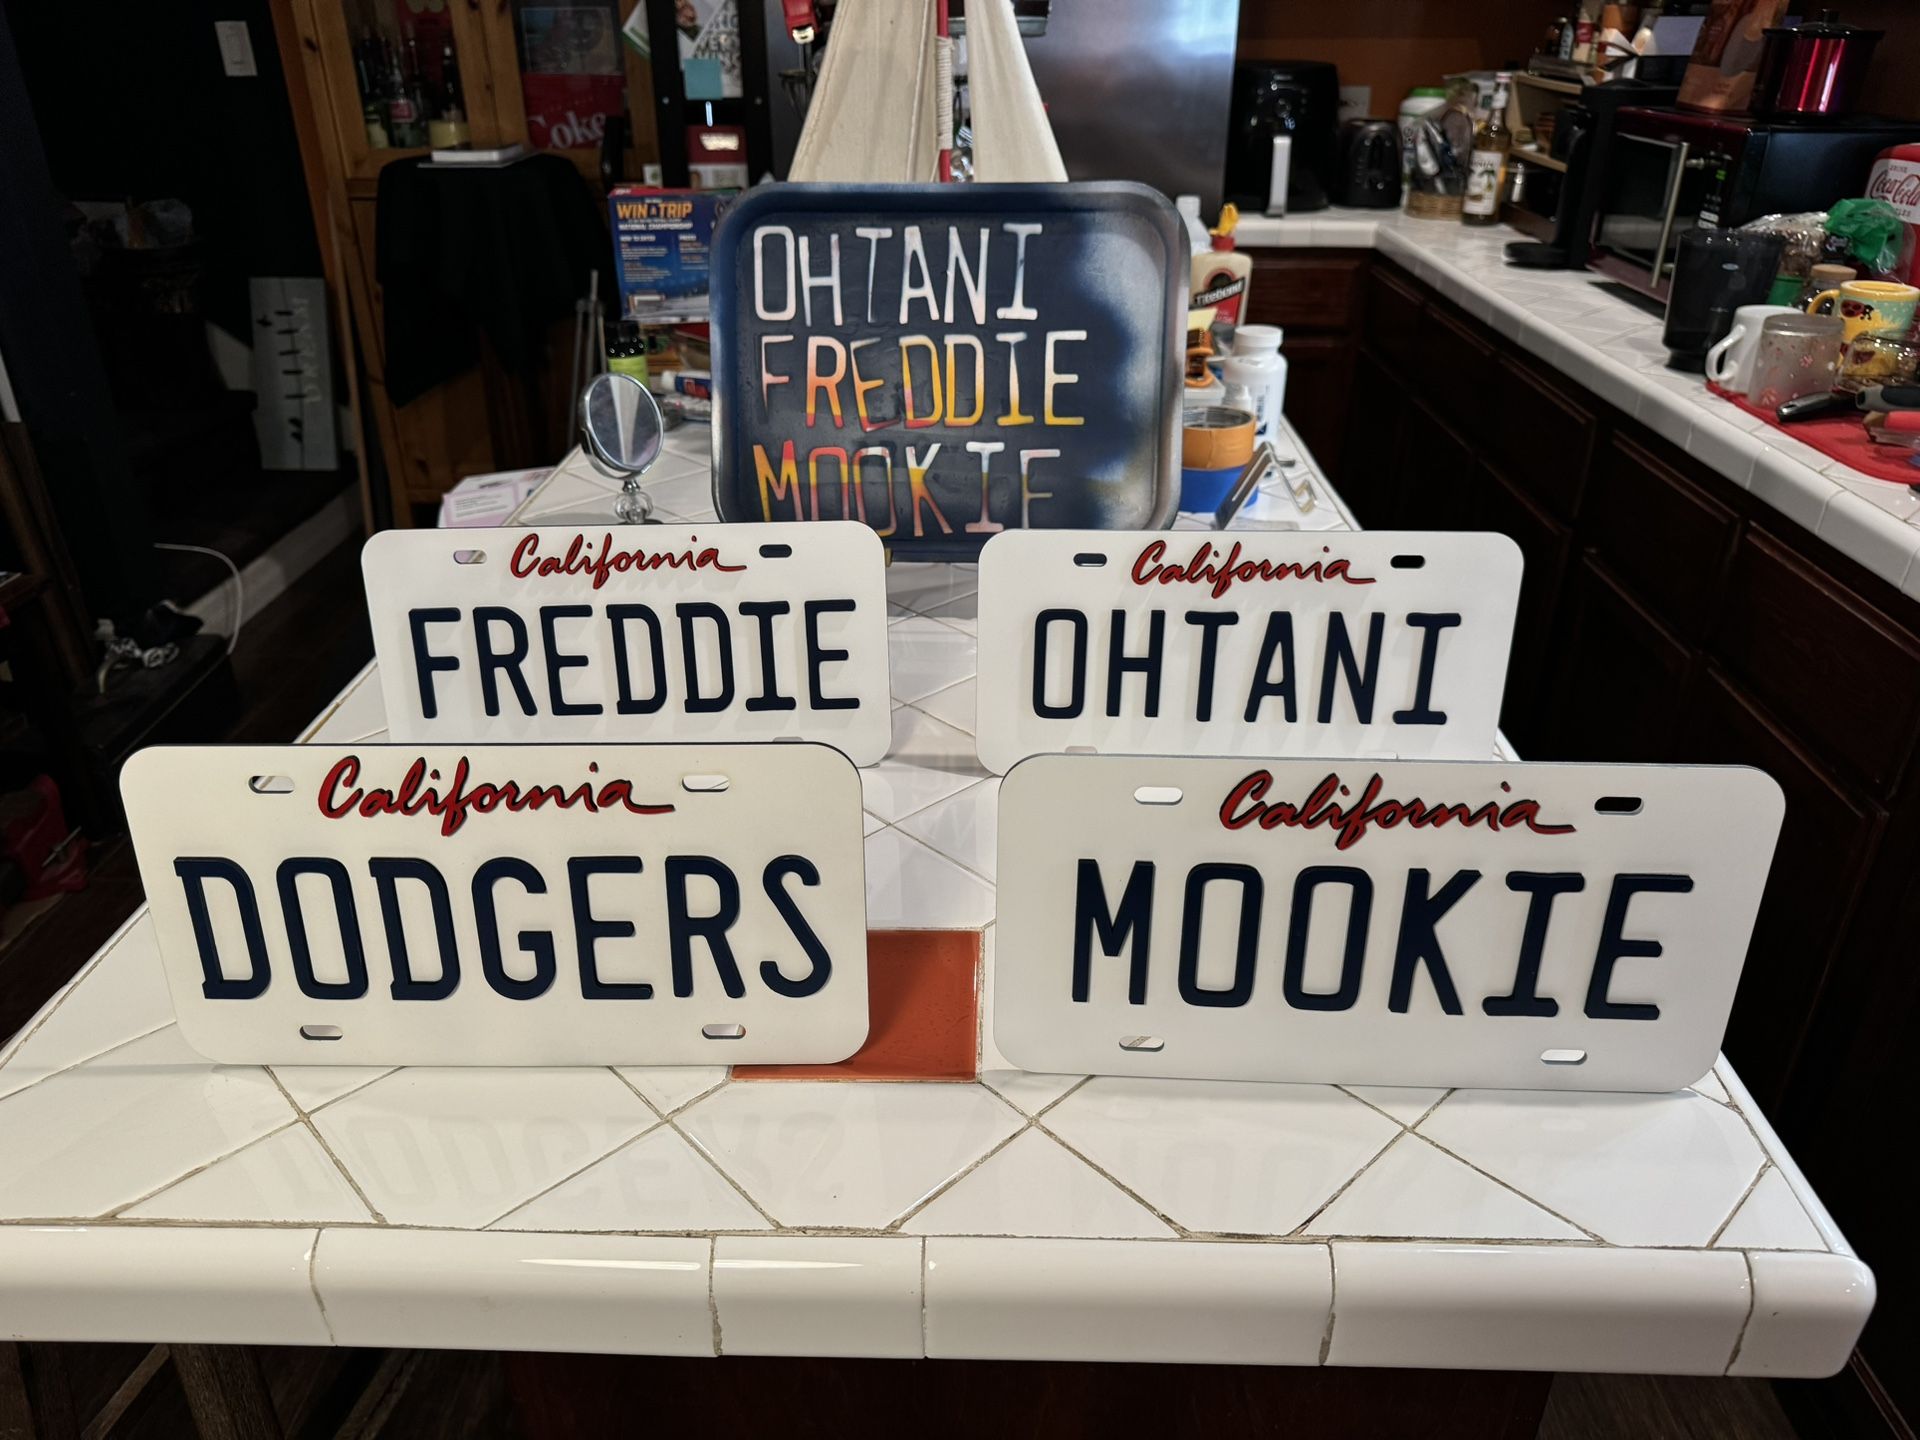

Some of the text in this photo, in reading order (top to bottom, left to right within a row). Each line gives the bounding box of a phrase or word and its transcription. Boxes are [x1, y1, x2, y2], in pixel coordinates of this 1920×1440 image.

[616, 202, 649, 219] WIN
[658, 201, 693, 218] TRIP
[753, 222, 1044, 328] OHTANI
[761, 330, 1088, 433] FREDDIE
[510, 533, 746, 590] California
[1131, 541, 1375, 599] California
[408, 598, 861, 720] FREDDIE
[1032, 608, 1462, 726] OHTANI
[317, 755, 676, 838] California
[1219, 769, 1576, 851] California
[172, 855, 833, 1002] DODGERS
[1071, 857, 1695, 1021] MOOKIE
